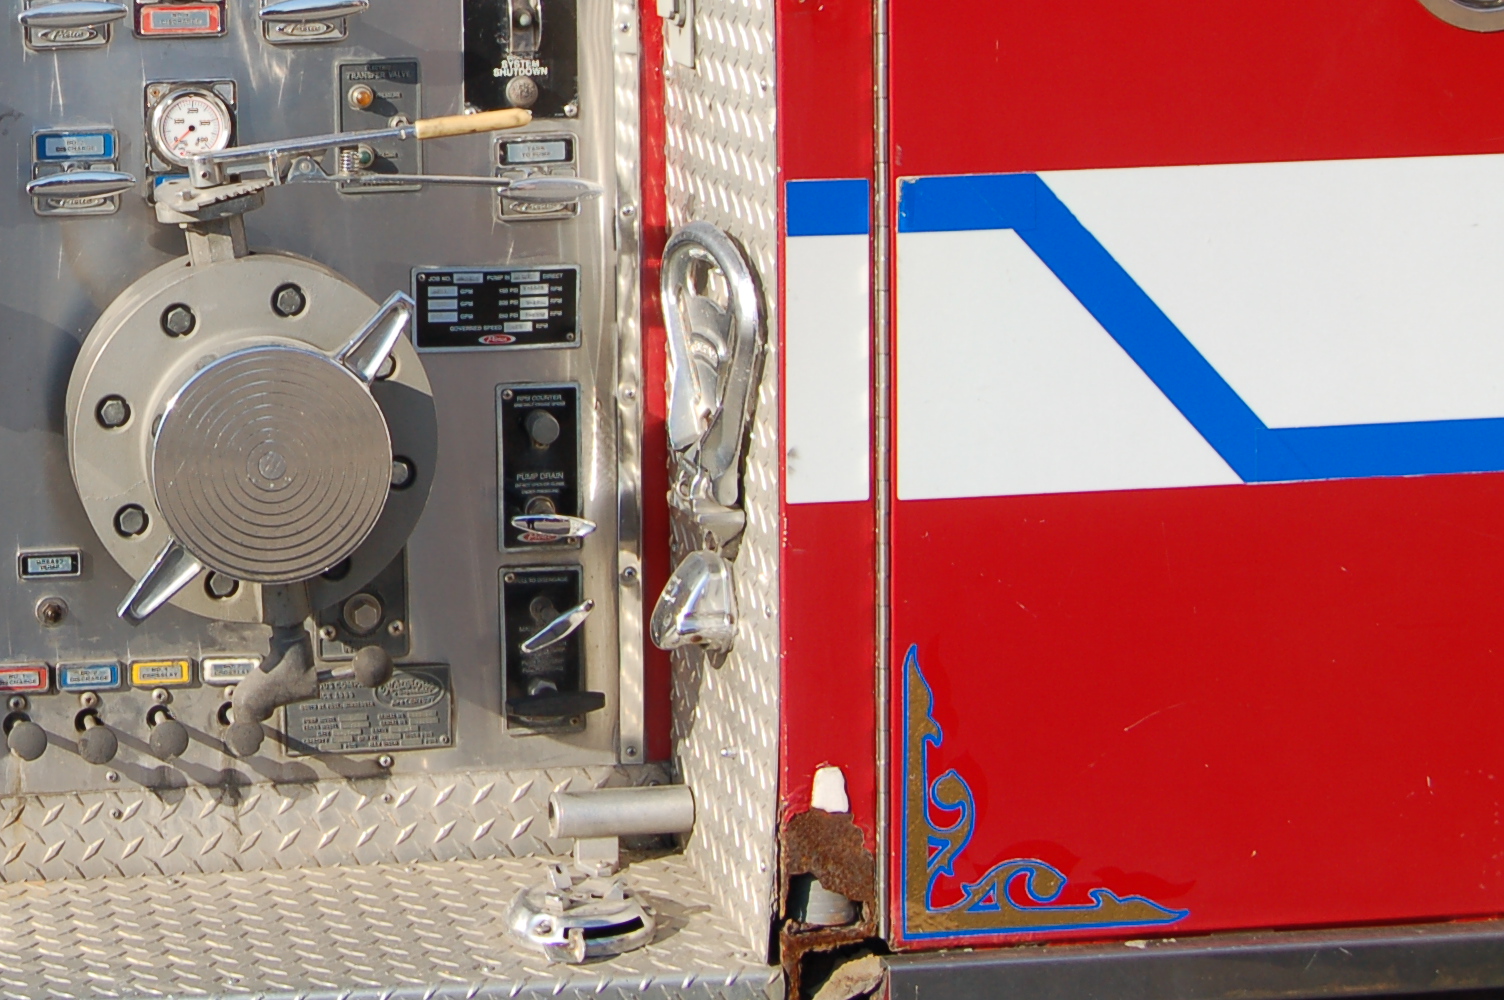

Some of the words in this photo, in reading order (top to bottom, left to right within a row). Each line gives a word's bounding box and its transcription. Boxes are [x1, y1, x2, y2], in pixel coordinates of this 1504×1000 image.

[501, 60, 540, 68] SYSTEM
[493, 67, 548, 78] SHUTDOWN
[516, 473, 538, 481] PUMP
[540, 472, 564, 480] DRAIN
